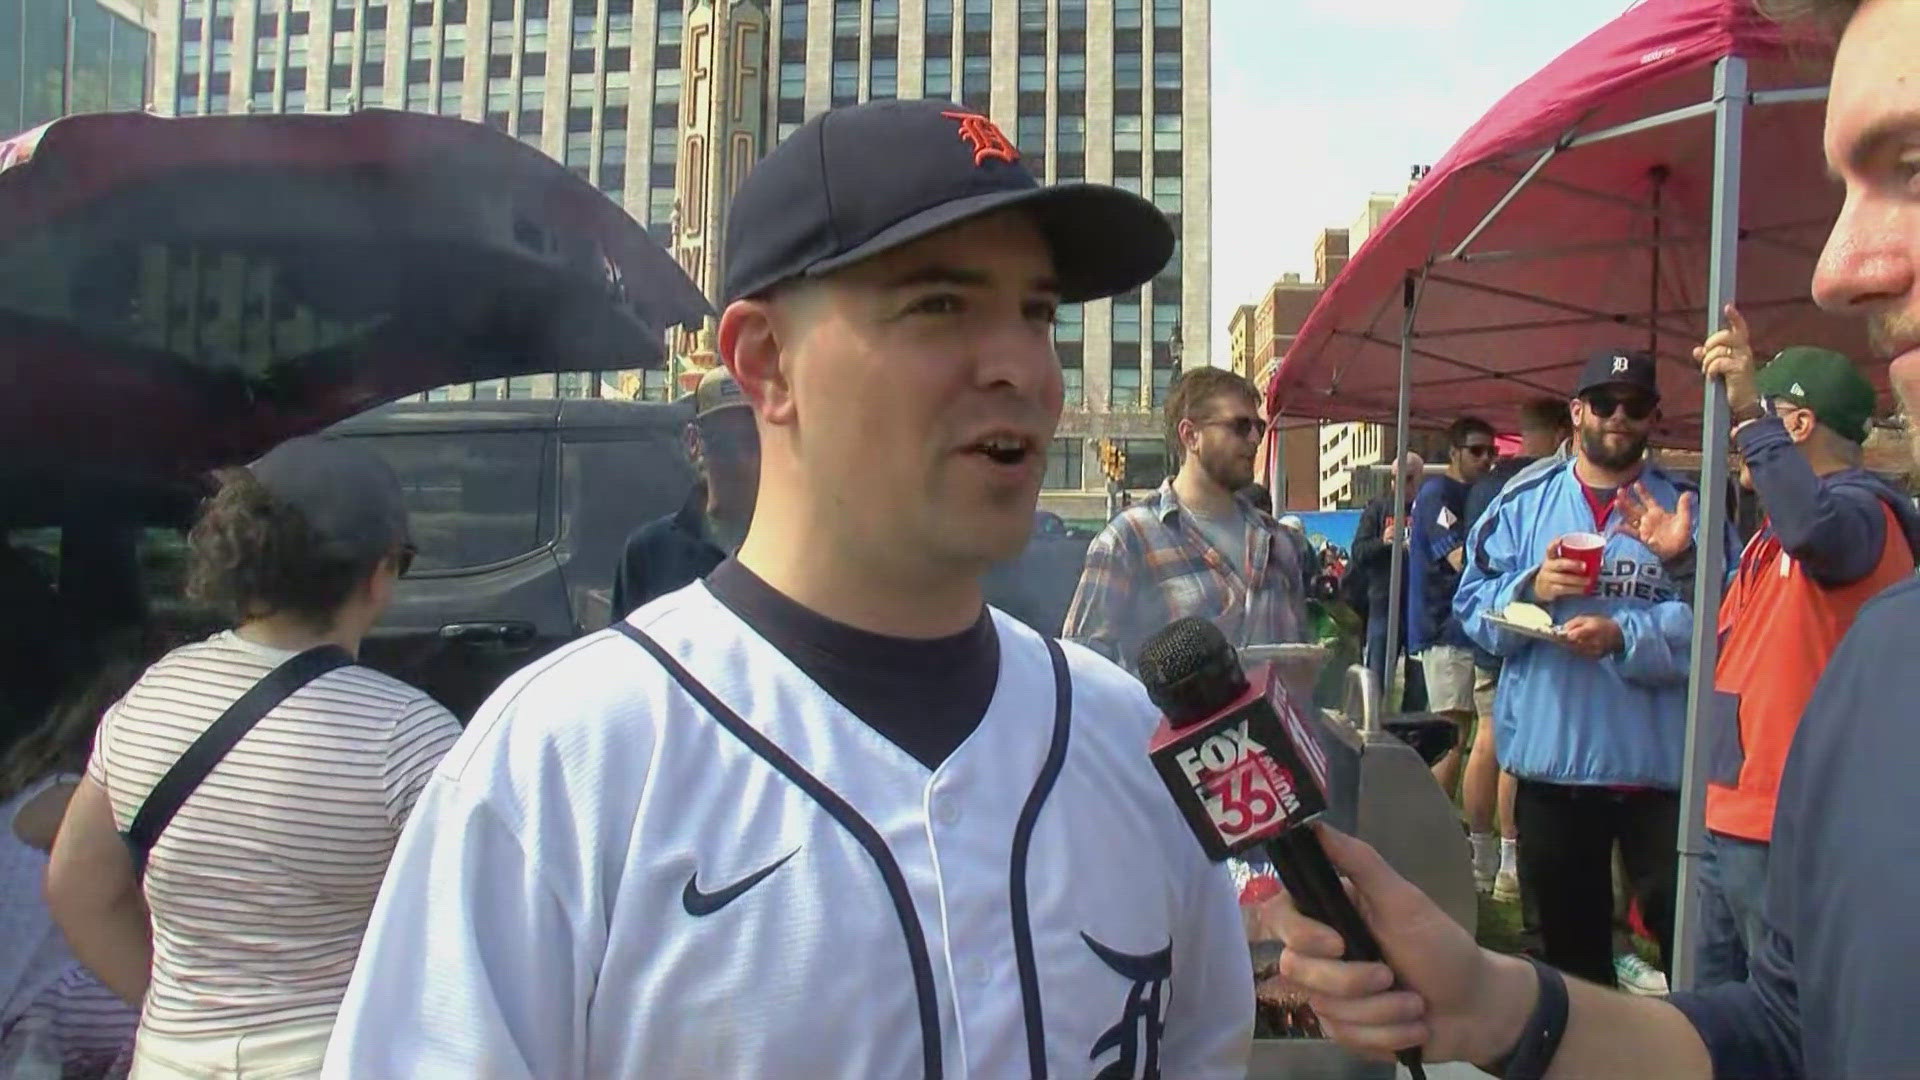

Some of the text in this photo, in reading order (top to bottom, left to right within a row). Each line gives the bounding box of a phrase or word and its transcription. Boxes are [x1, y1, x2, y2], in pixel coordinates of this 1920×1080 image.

[1611, 355, 1629, 374] D
[1175, 719, 1267, 787] FOX
[1206, 768, 1277, 836] 36
